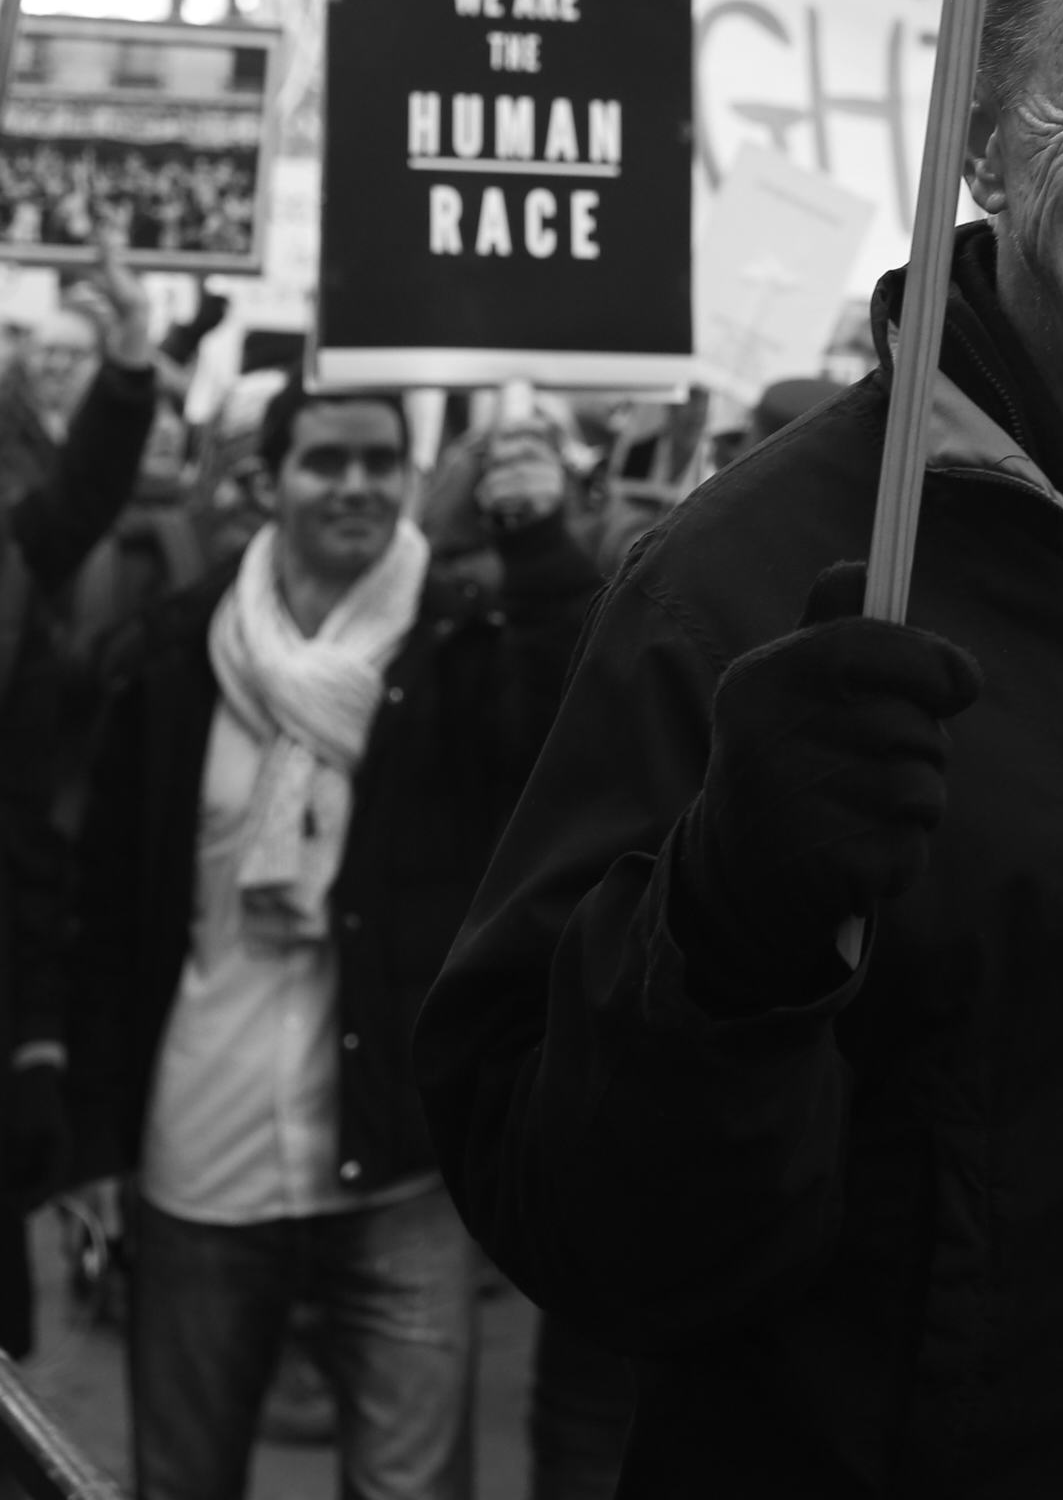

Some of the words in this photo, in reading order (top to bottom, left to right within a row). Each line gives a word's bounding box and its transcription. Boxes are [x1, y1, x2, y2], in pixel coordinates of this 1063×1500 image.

[486, 31, 542, 74] THE
[408, 91, 623, 164] HUMAN
[429, 184, 601, 261] RACE
